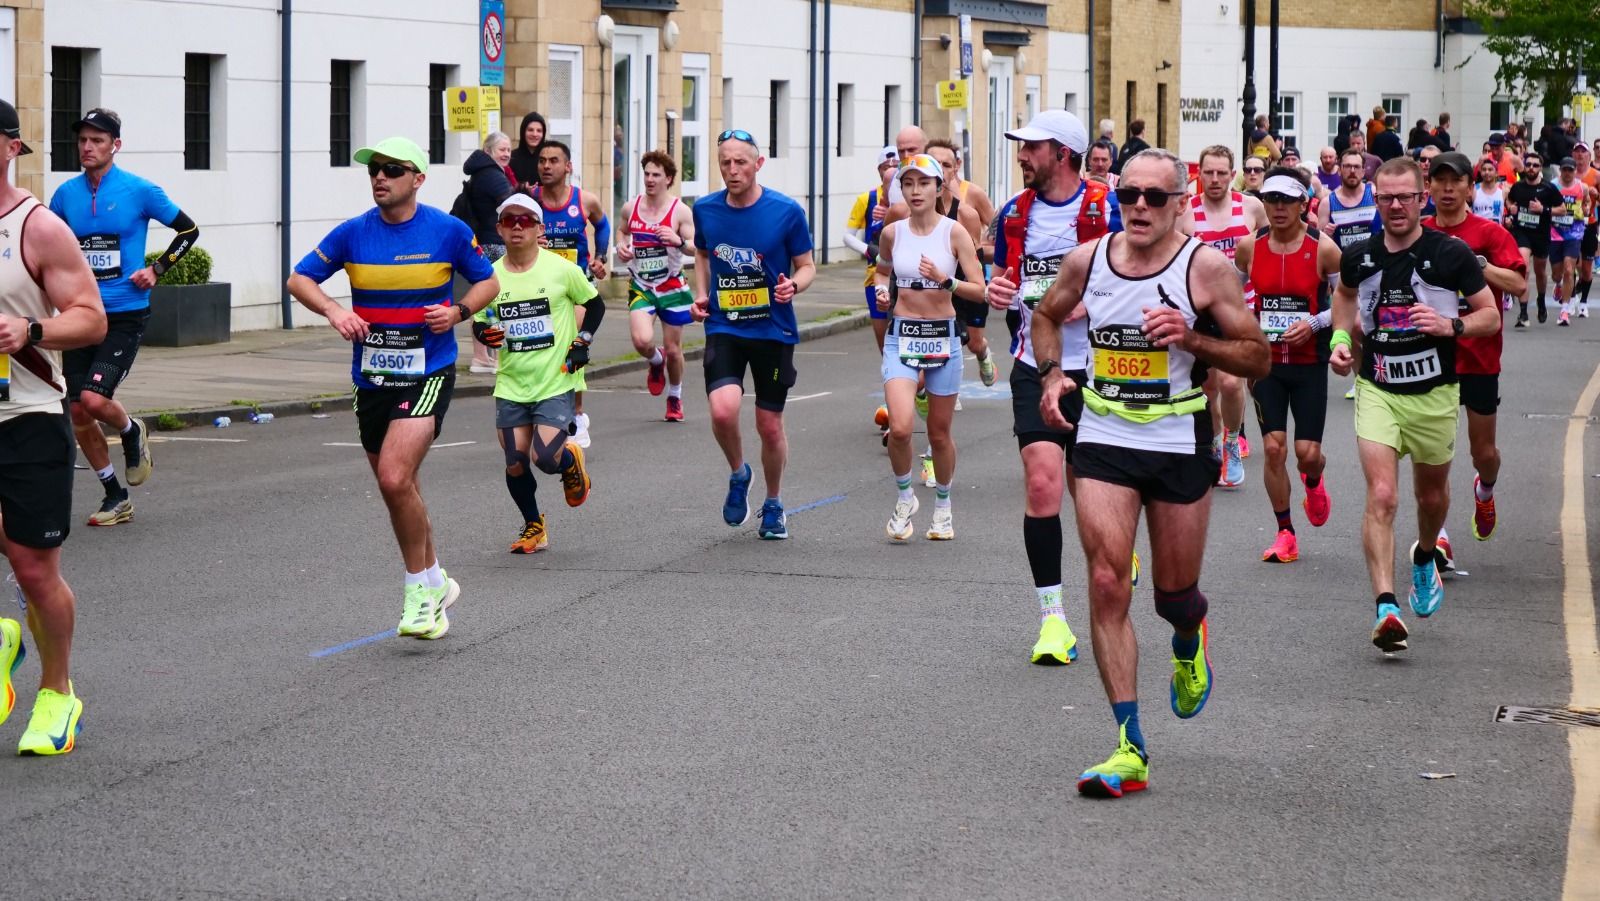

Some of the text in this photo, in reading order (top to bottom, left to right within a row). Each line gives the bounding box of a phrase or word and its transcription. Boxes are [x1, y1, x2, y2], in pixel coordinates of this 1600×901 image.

[1180, 98, 1224, 110] DUNBAR
[1183, 111, 1221, 122] WHARF
[631, 221, 643, 229] Mr
[1214, 236, 1234, 250] STU
[87, 255, 112, 267] 1051
[734, 251, 753, 263] AJ
[641, 260, 664, 270] 41220
[1027, 259, 1047, 272] tcs
[719, 277, 736, 288] tcs
[729, 293, 758, 306] 3070
[1263, 297, 1279, 309] tcs
[500, 306, 519, 317] tcs
[510, 320, 544, 336] 46880
[902, 323, 919, 335] tcs
[366, 333, 383, 345] tcs
[1093, 330, 1119, 346] tcs
[907, 341, 942, 353] 45005
[370, 354, 414, 369] 49507
[1108, 357, 1150, 377] 3662
[1389, 355, 1435, 379] MATT
